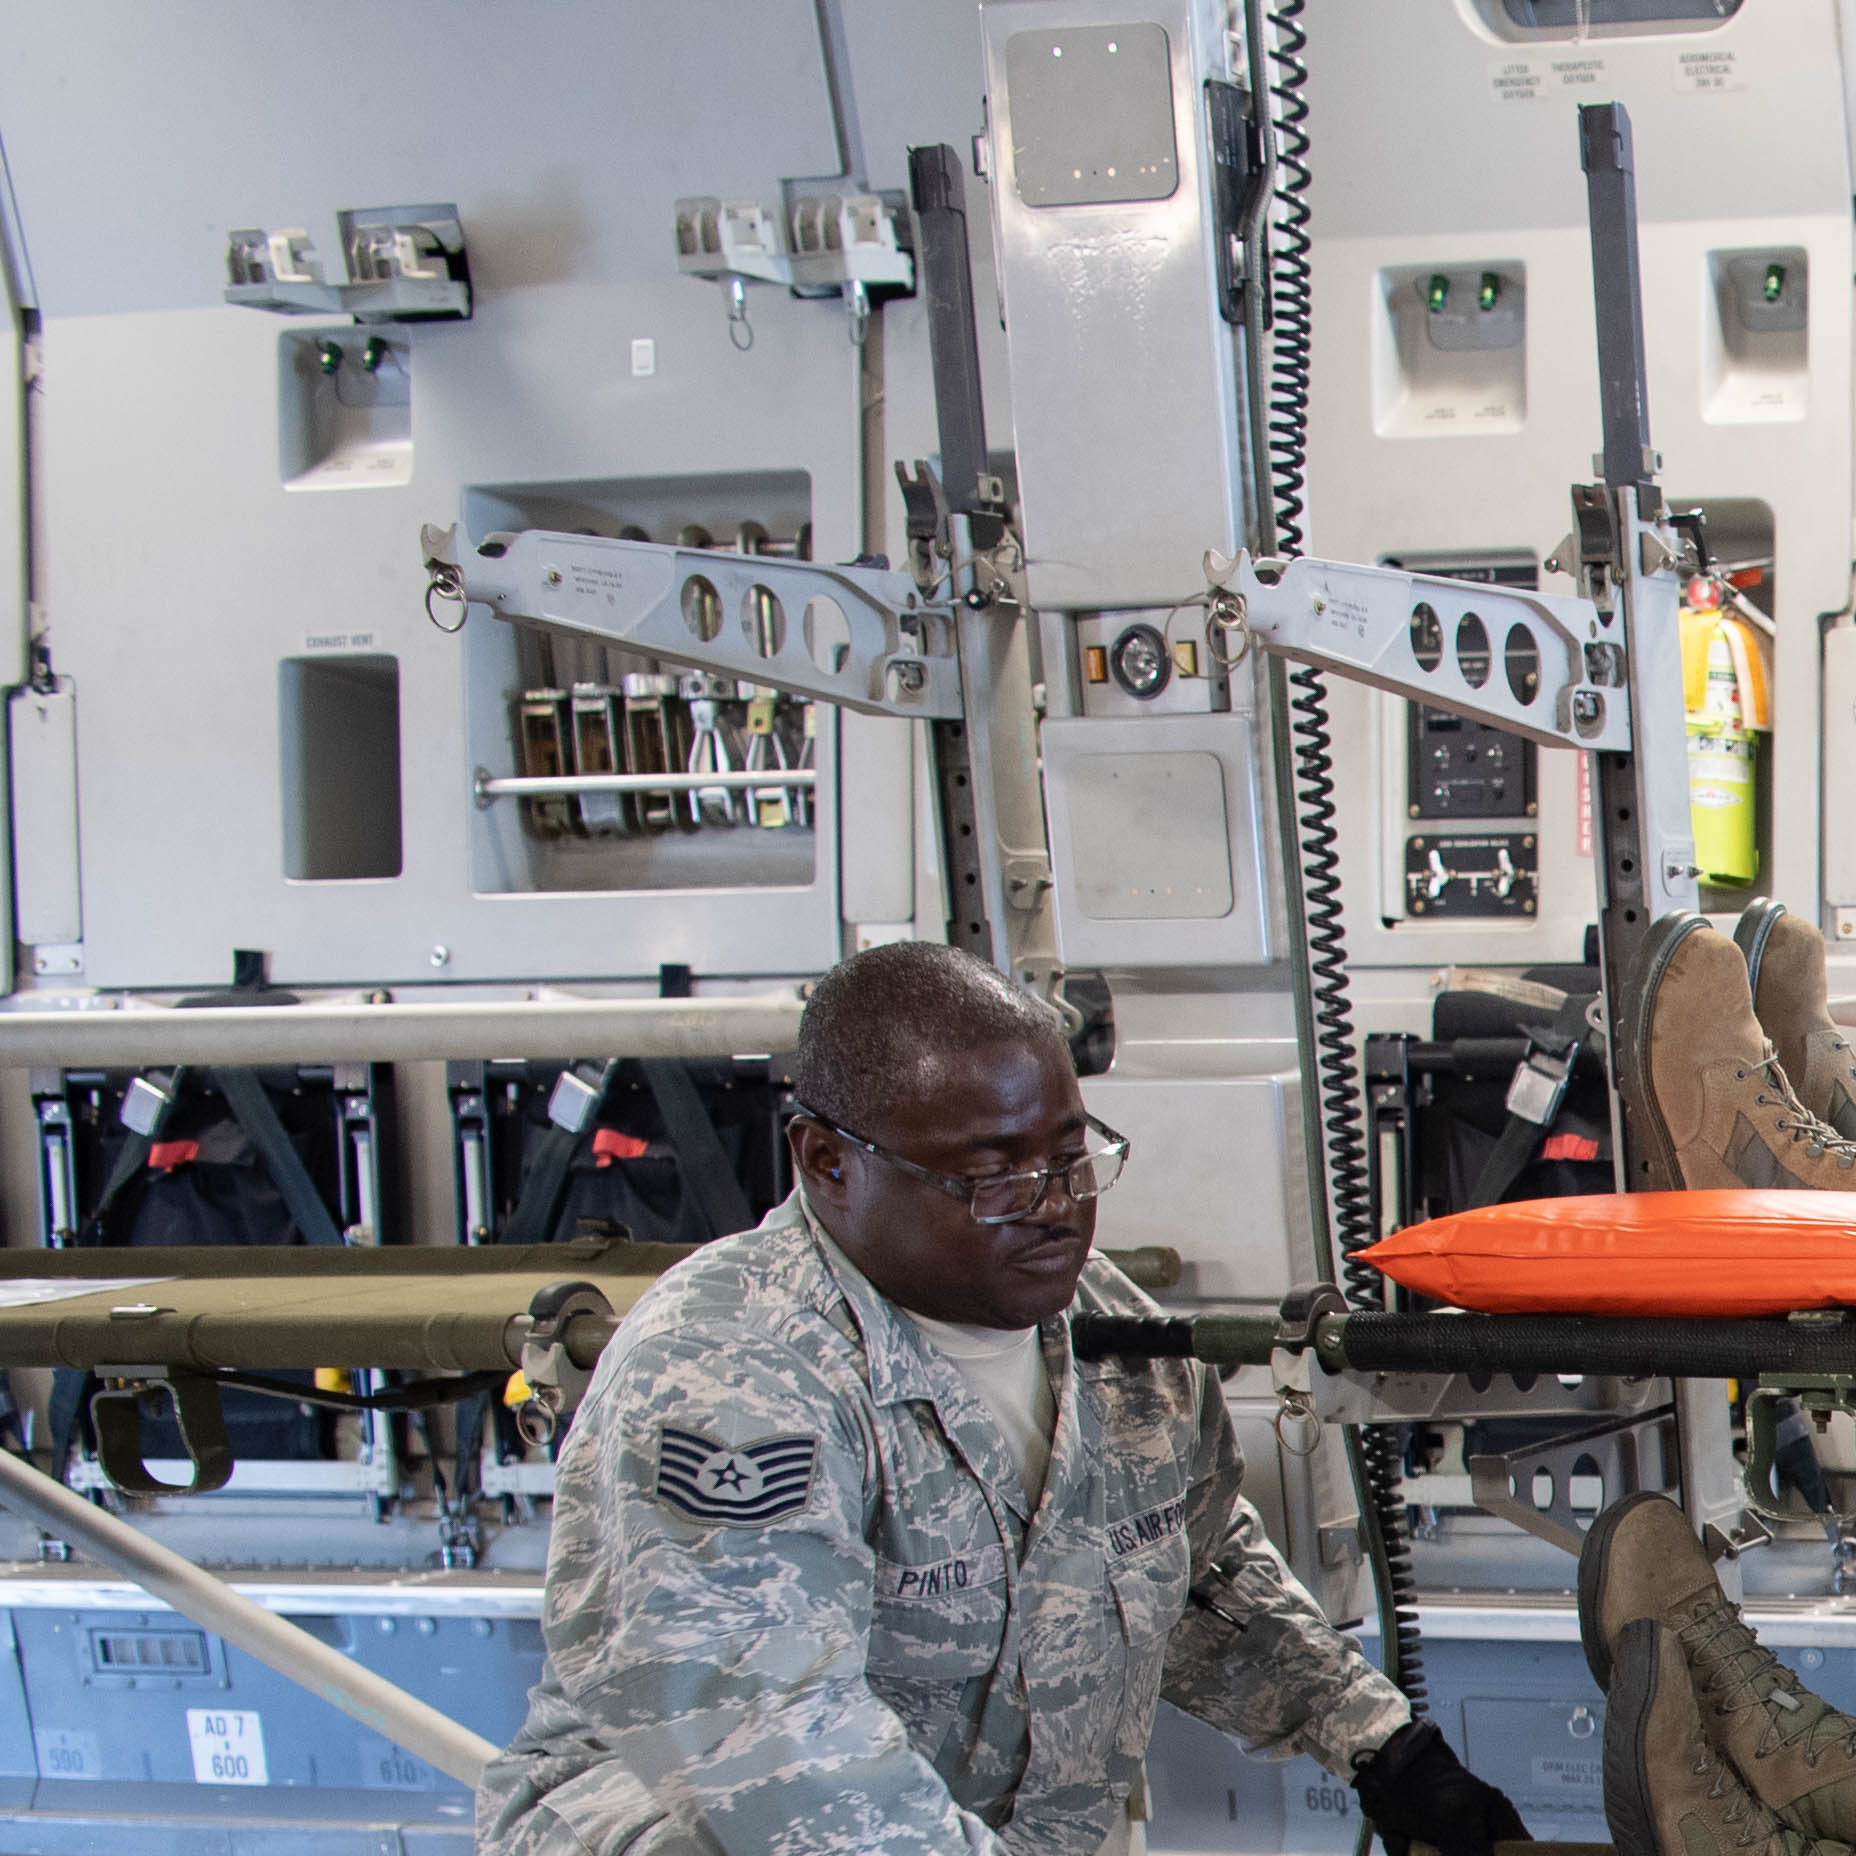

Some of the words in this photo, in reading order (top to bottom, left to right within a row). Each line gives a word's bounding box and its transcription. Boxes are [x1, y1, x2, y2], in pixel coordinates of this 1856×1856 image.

[351, 633, 374, 647] VENT
[1135, 1511, 1161, 1546] AIR
[1165, 1499, 1186, 1533] FO
[898, 1559, 968, 1595] PINTO
[204, 1716, 227, 1736] AD
[235, 1716, 244, 1736] 7
[212, 1755, 248, 1778] 600
[379, 1761, 416, 1783] 610
[1306, 1787, 1348, 1813] 660
